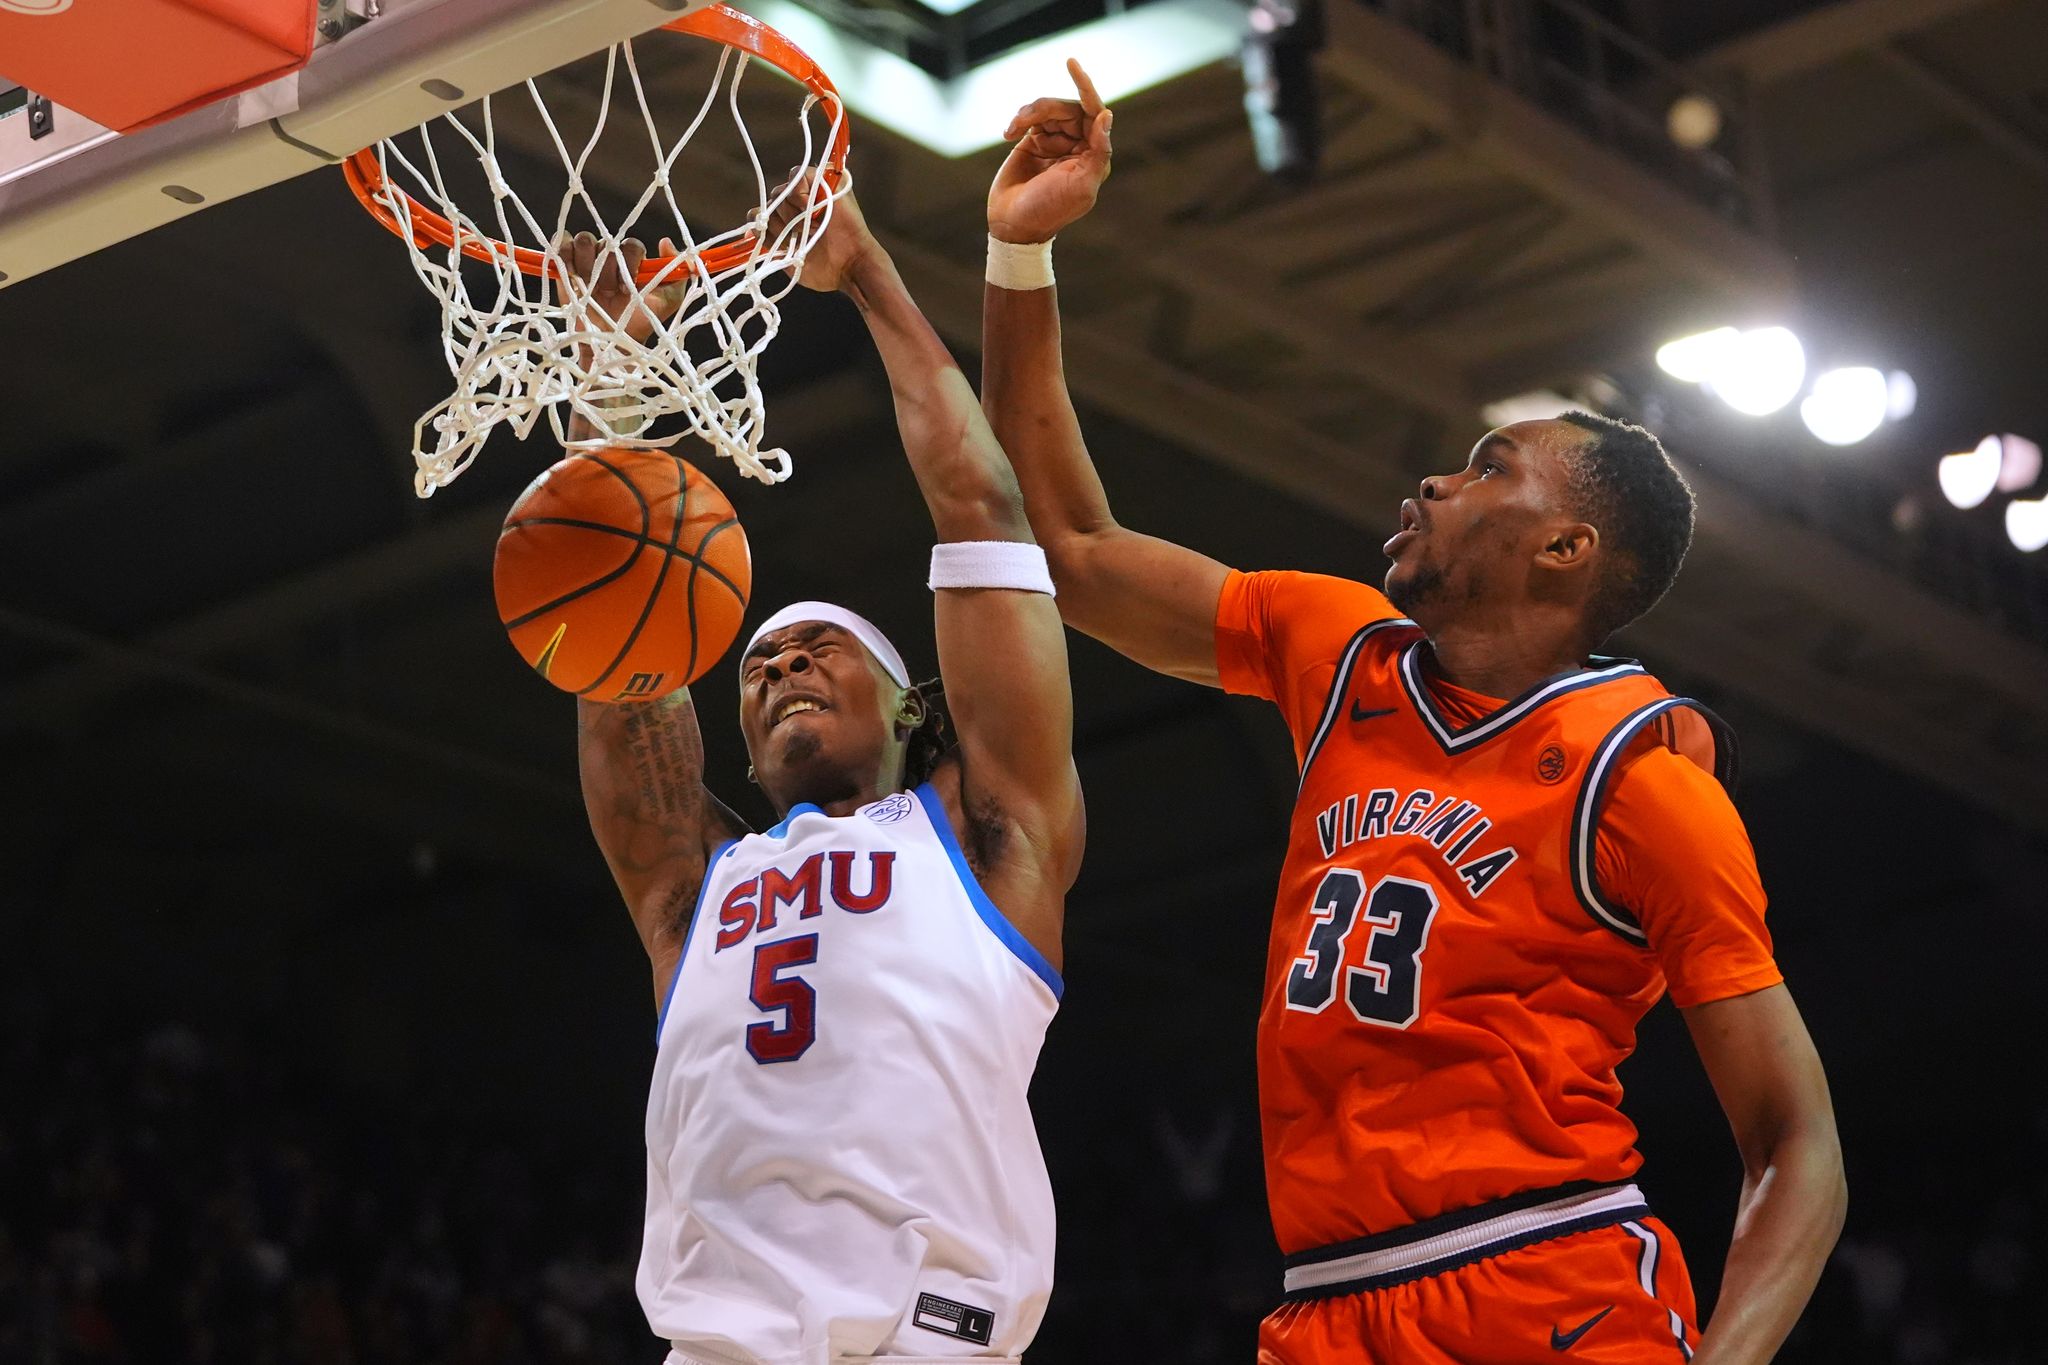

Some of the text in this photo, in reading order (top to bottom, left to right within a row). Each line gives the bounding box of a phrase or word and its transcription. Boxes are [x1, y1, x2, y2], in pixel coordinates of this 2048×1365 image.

[1316, 788, 1519, 899] VIRGINIA
[715, 851, 897, 954] SMU
[1285, 867, 1440, 1031] 33
[745, 932, 819, 1065] 5
[923, 1297, 962, 1313] ENGINEERED
[969, 1318, 979, 1333] L
